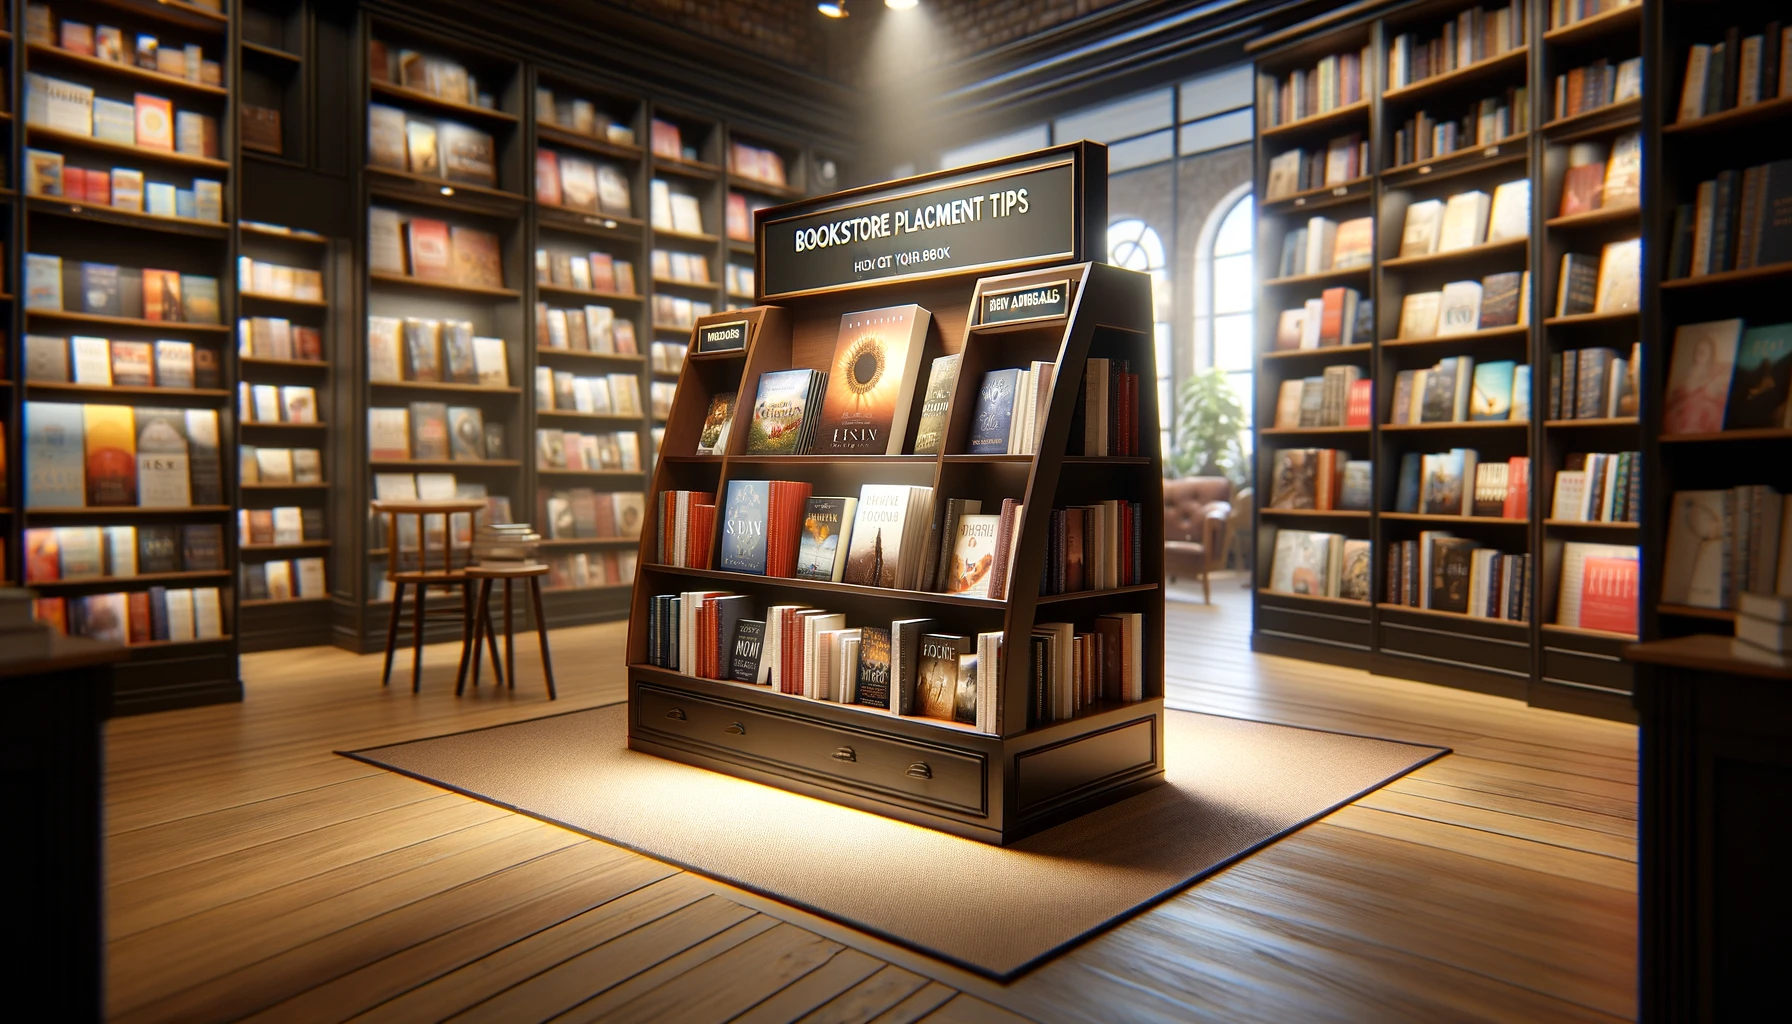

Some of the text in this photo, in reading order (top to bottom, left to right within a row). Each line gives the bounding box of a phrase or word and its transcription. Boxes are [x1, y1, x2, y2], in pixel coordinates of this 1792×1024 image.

[795, 188, 1029, 252] BOOKSTORE PLACMENT TIPS
